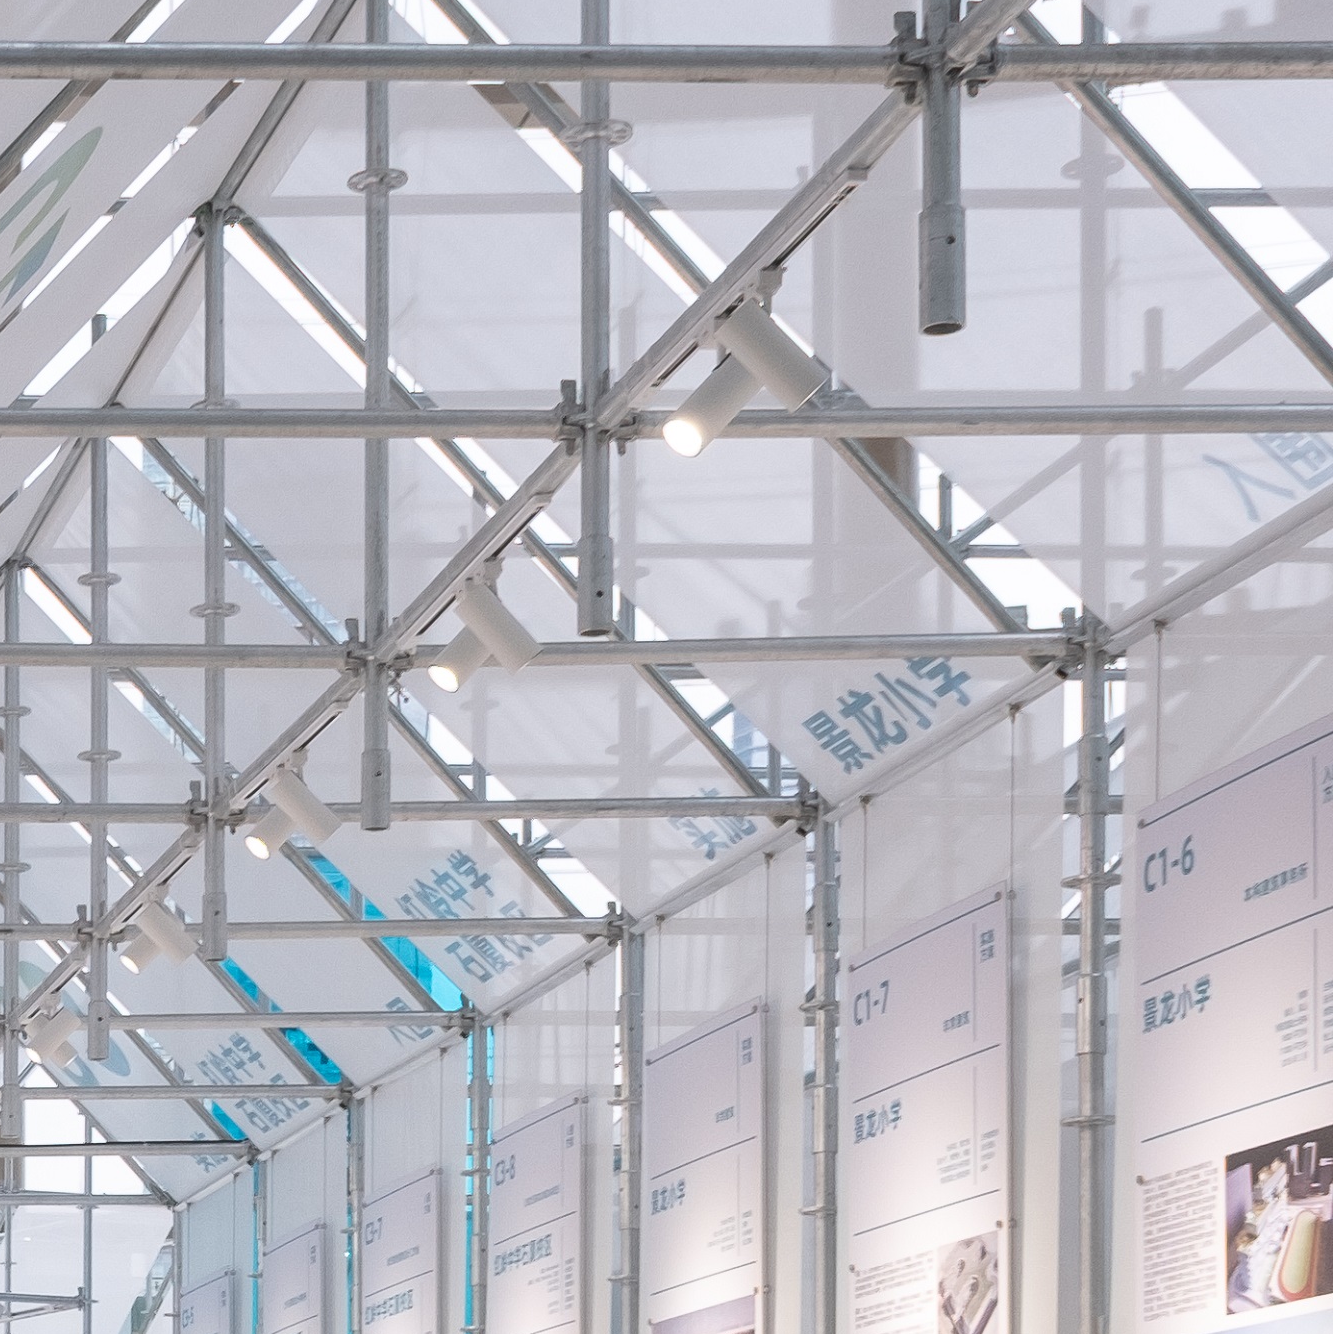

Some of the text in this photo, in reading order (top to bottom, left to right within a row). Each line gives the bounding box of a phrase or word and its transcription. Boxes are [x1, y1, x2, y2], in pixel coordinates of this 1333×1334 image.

[801, 655, 972, 775] 景龙小学
[1142, 834, 1196, 895] C1-6
[852, 979, 891, 1027] C1-7
[1141, 973, 1213, 1035] 景龙小学
[852, 1097, 904, 1145] 景龙小学
